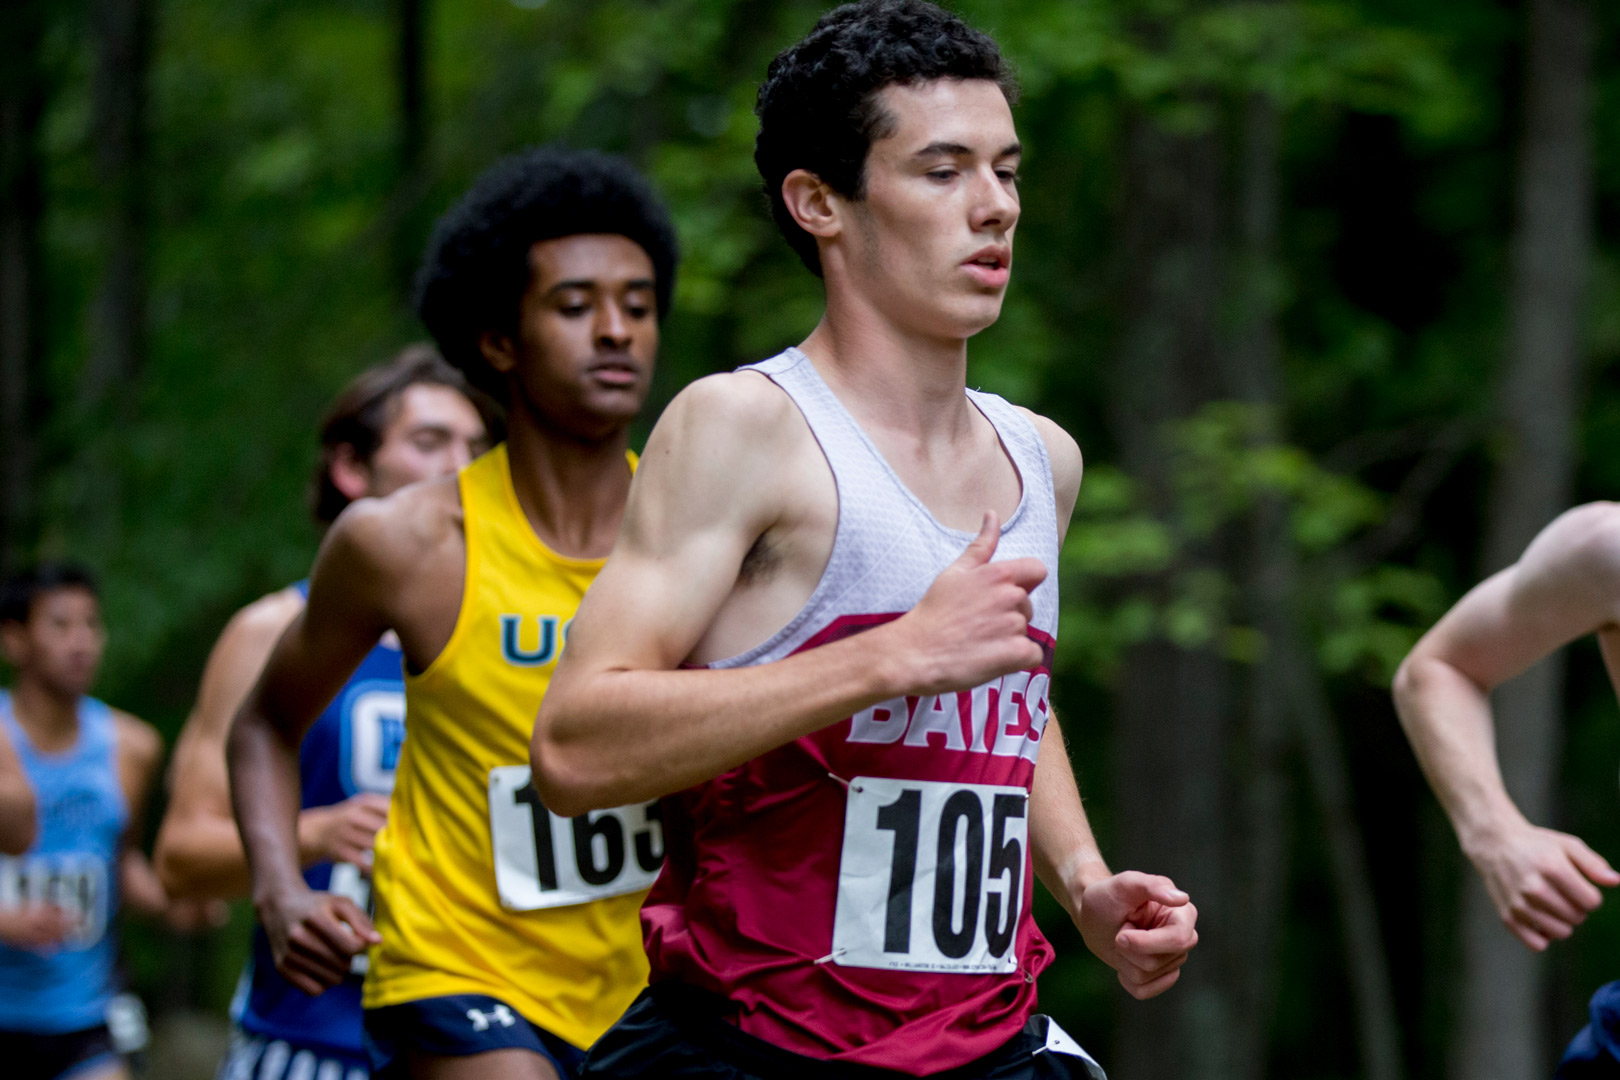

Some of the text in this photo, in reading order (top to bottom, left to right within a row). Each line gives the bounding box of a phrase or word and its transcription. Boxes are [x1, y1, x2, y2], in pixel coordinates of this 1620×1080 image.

[500, 614, 573, 667] U
[845, 671, 1050, 764] BATES
[876, 789, 1026, 960] 105
